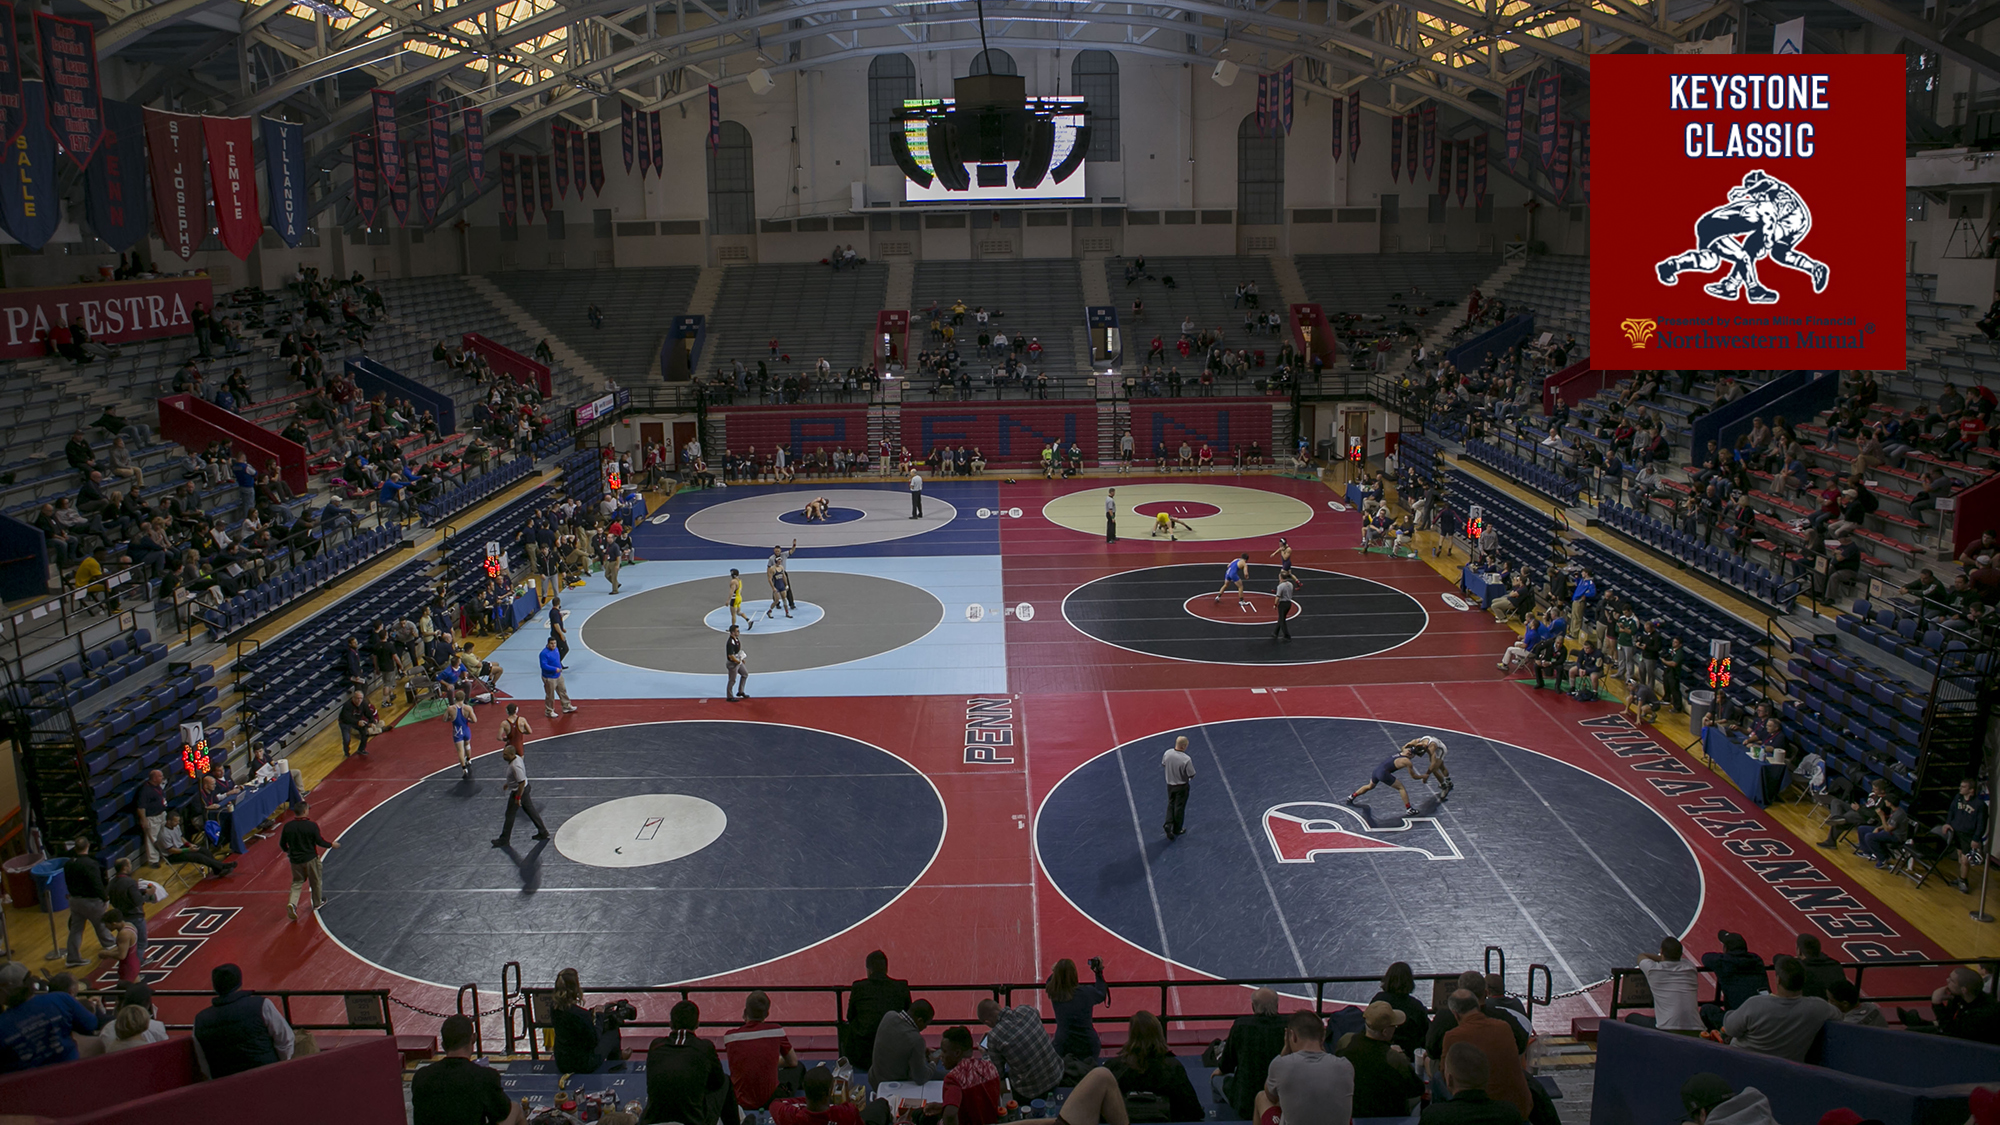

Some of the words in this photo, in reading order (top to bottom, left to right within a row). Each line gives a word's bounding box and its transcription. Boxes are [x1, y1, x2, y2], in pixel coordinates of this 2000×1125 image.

[69, 133, 91, 153] 1972
[16, 135, 37, 217] SALLE
[225, 141, 243, 220] TEMPLE
[280, 126, 296, 236] VILLANOVA
[1338, 425, 1345, 433] 4
[666, 438, 672, 446] 3
[1474, 507, 1480, 517] 3
[489, 543, 498, 555] 4
[192, 725, 201, 743] 2
[963, 697, 1015, 765] PENN
[1578, 714, 1931, 963] PENNSYLVANIA
